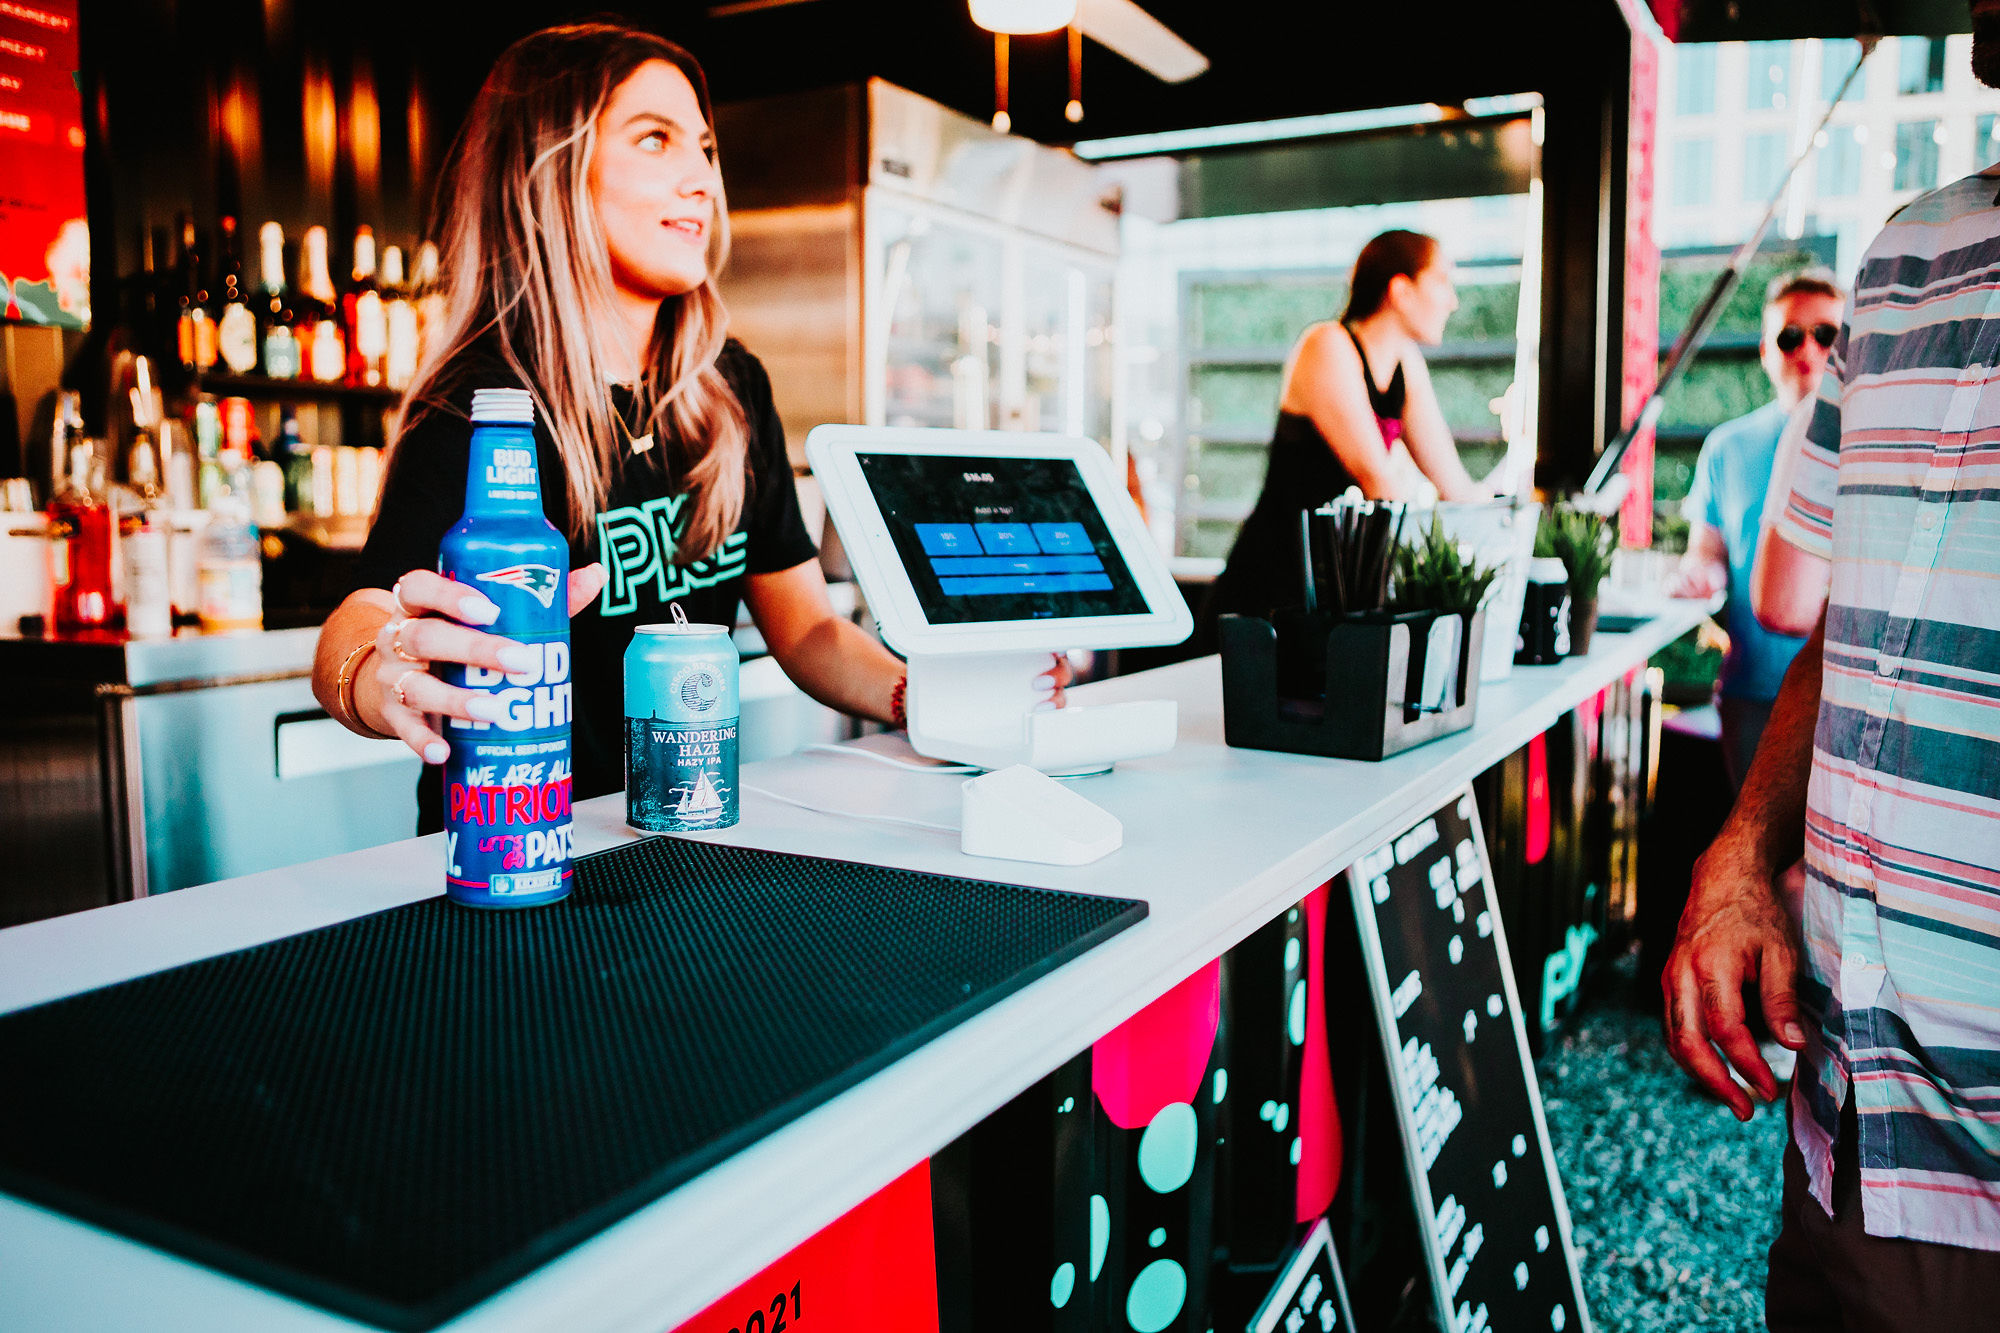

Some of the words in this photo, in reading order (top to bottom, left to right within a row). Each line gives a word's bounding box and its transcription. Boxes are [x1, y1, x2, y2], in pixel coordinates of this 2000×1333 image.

[493, 448, 532, 467] BUD
[486, 465, 537, 485] LIGHT
[652, 726, 737, 744] WANDERING
[679, 743, 720, 757] HAZE
[677, 758, 705, 767] HAZY
[707, 756, 722, 765] IPA
[465, 765, 498, 788] WE
[502, 761, 547, 788] ARE
[450, 774, 573, 826] PATRIOT
